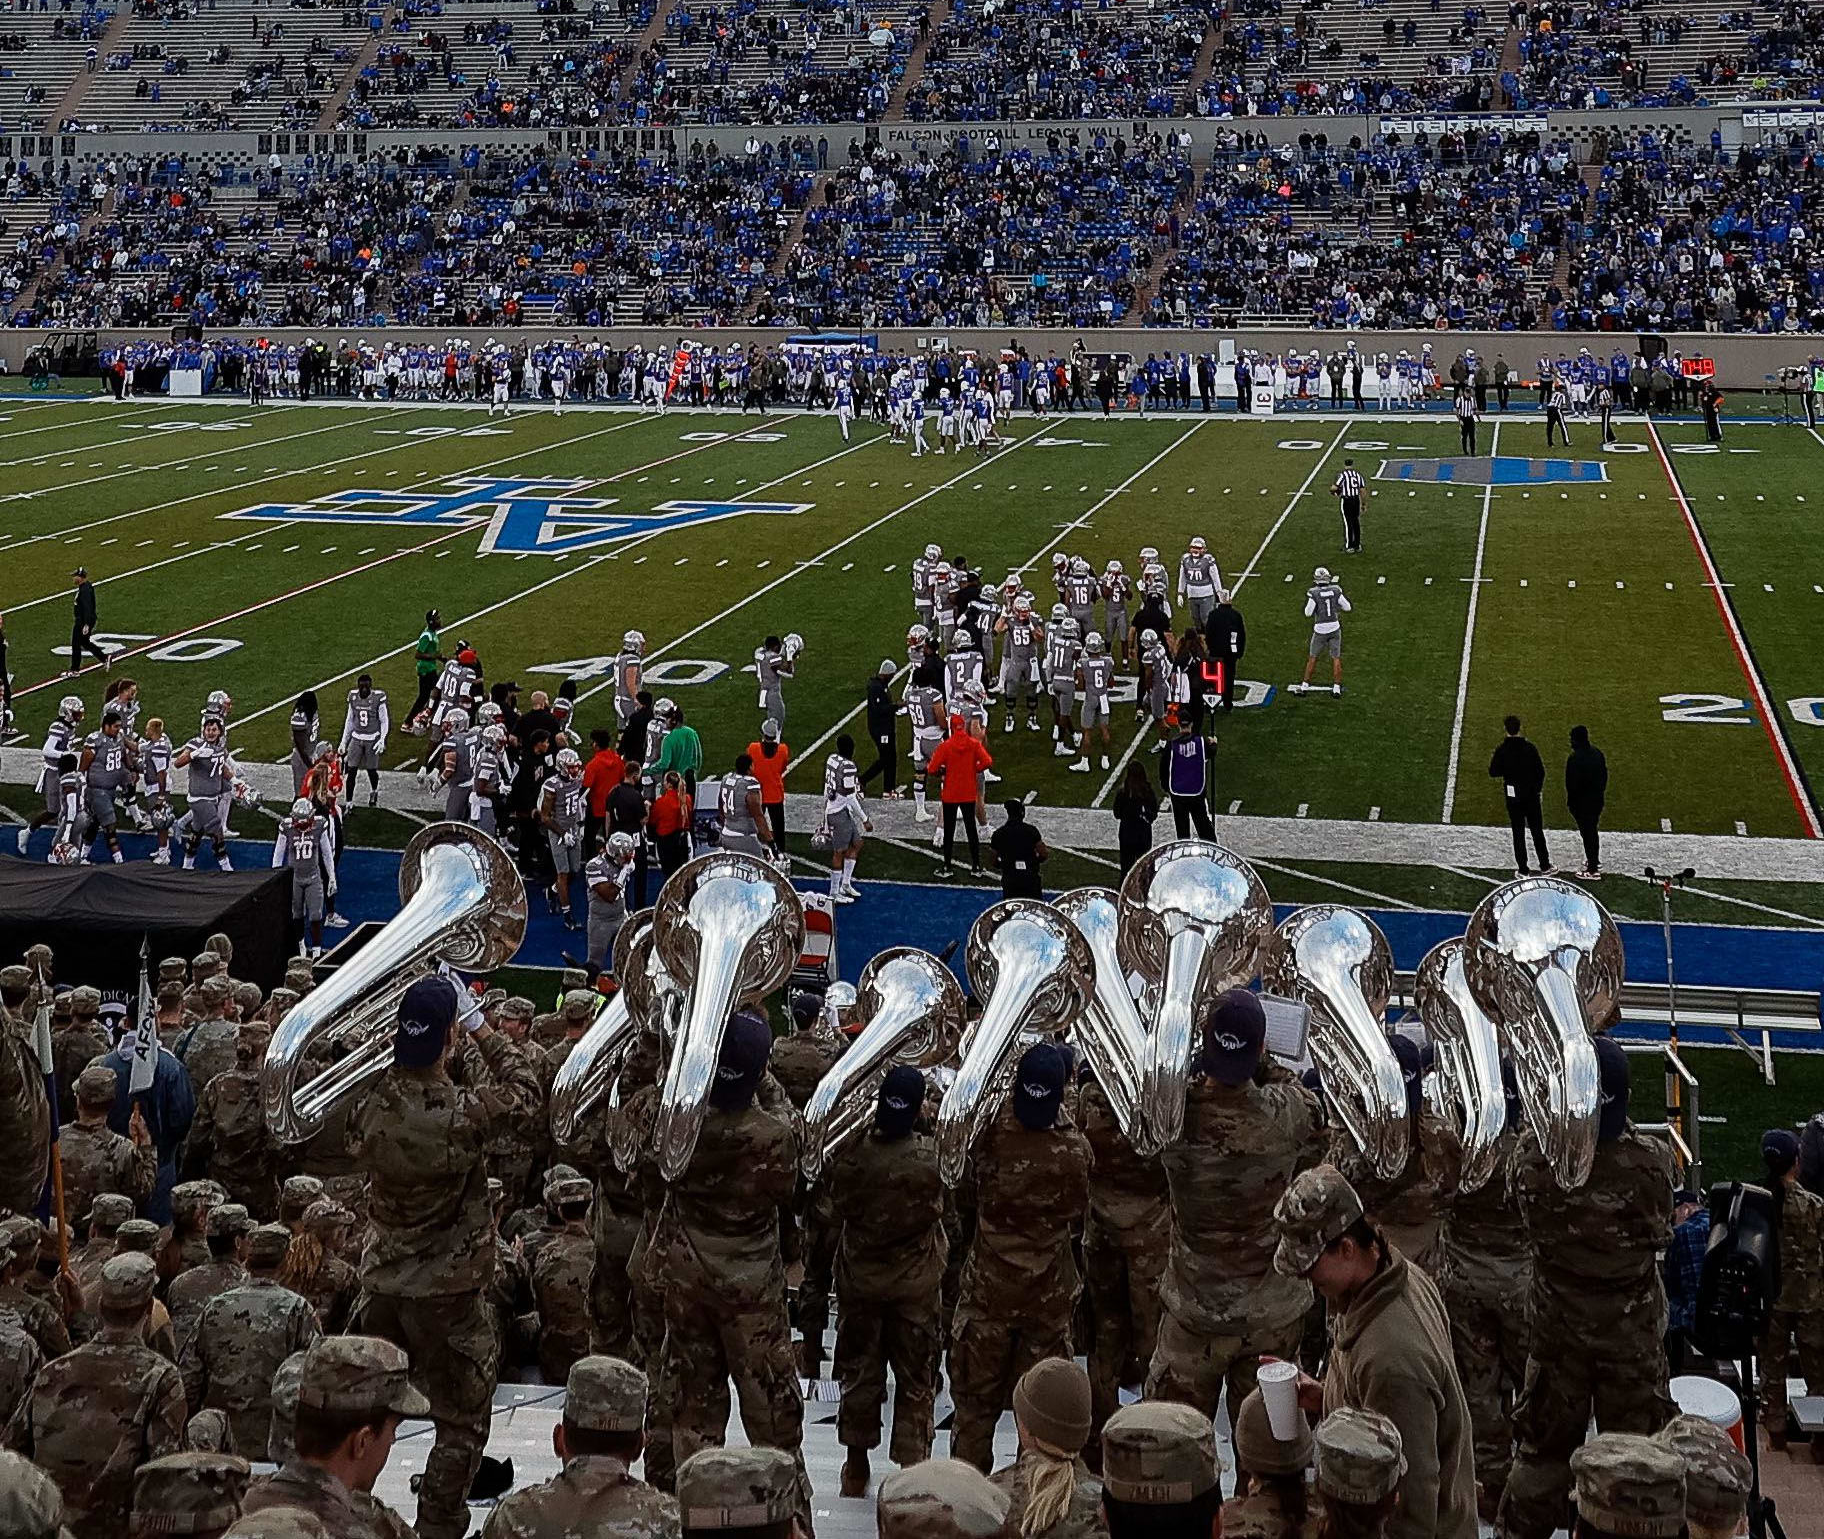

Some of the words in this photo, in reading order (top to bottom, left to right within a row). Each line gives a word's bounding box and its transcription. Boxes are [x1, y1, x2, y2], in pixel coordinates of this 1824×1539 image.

[1087, 127, 1124, 138] WALL
[1074, 586, 1088, 605] 16
[1326, 598, 1331, 617] 1
[1012, 629, 1030, 646] 65
[1053, 646, 1065, 668] 11
[526, 656, 729, 686] 40
[956, 662, 965, 683] 2
[1094, 669, 1104, 689] 6
[1202, 661, 1224, 694] 4
[359, 710, 369, 727] 9
[294, 841, 314, 860] 10
